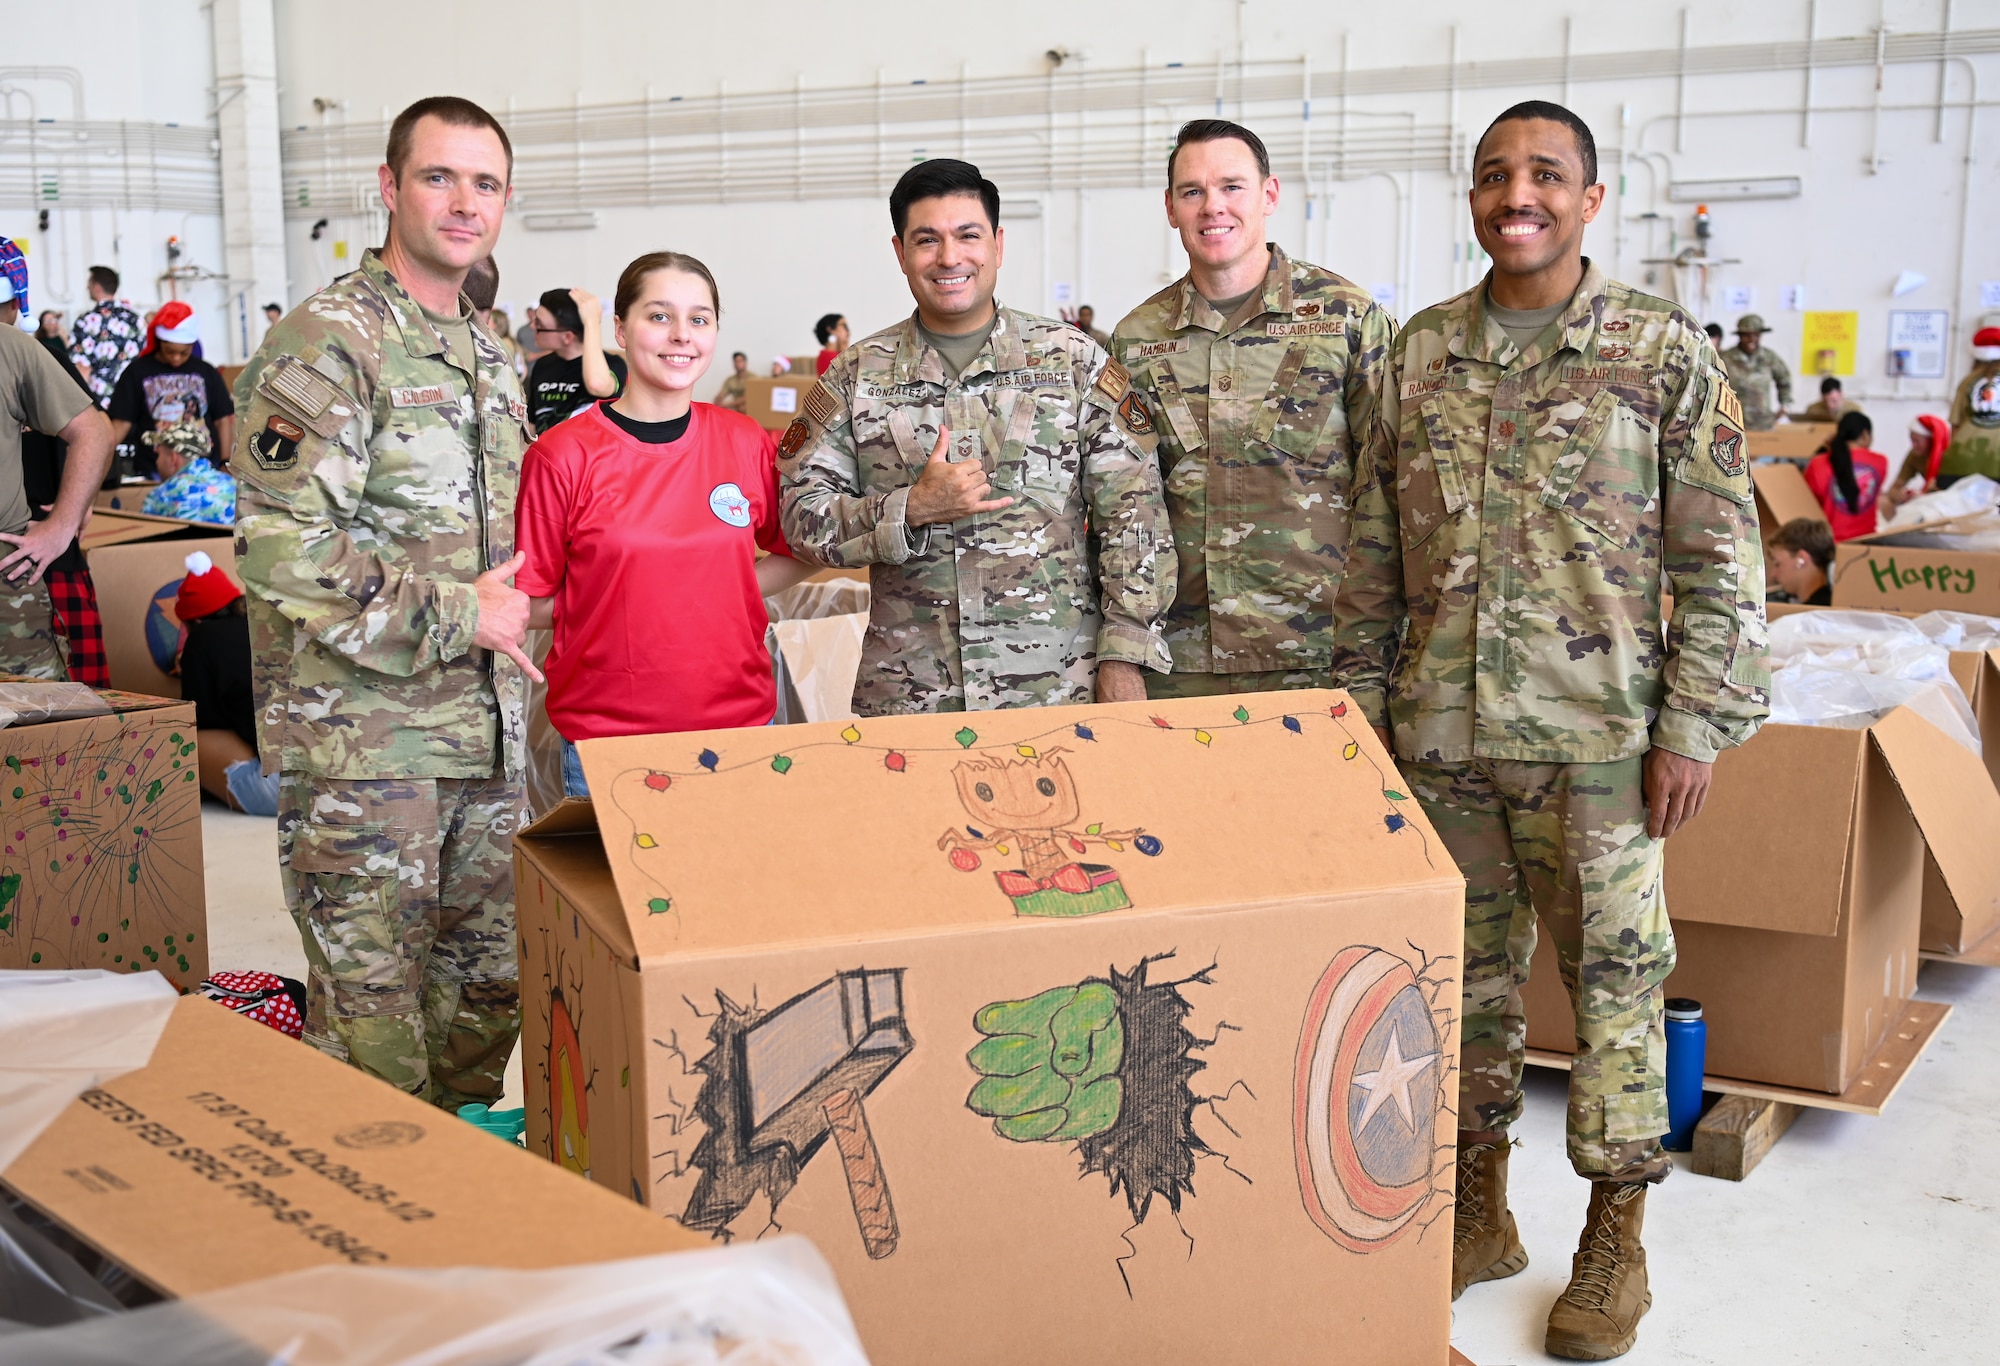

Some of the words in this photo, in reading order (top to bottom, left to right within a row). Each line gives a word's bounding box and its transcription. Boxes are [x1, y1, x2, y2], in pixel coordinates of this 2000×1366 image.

[1269, 323, 1287, 336] U.S.
[1290, 322, 1307, 335] AIR
[1309, 321, 1343, 334] FORCE
[1140, 341, 1178, 356] HAMBLIN
[996, 377, 1014, 387] U.S.
[1015, 375, 1031, 386] AIR
[1034, 372, 1068, 384] FORCE
[1104, 364, 1127, 394] FM
[1589, 367, 1611, 381] AIR
[1614, 367, 1656, 386] FORCE
[538, 382, 580, 393] OPTIC
[868, 386, 922, 398] GONZALEZ
[1724, 390, 1741, 423] FM
[1868, 556, 1976, 594] Happy
[233, 1117, 293, 1147] Cube
[126, 1121, 186, 1147] FED
[167, 1146, 244, 1183] SPEC
